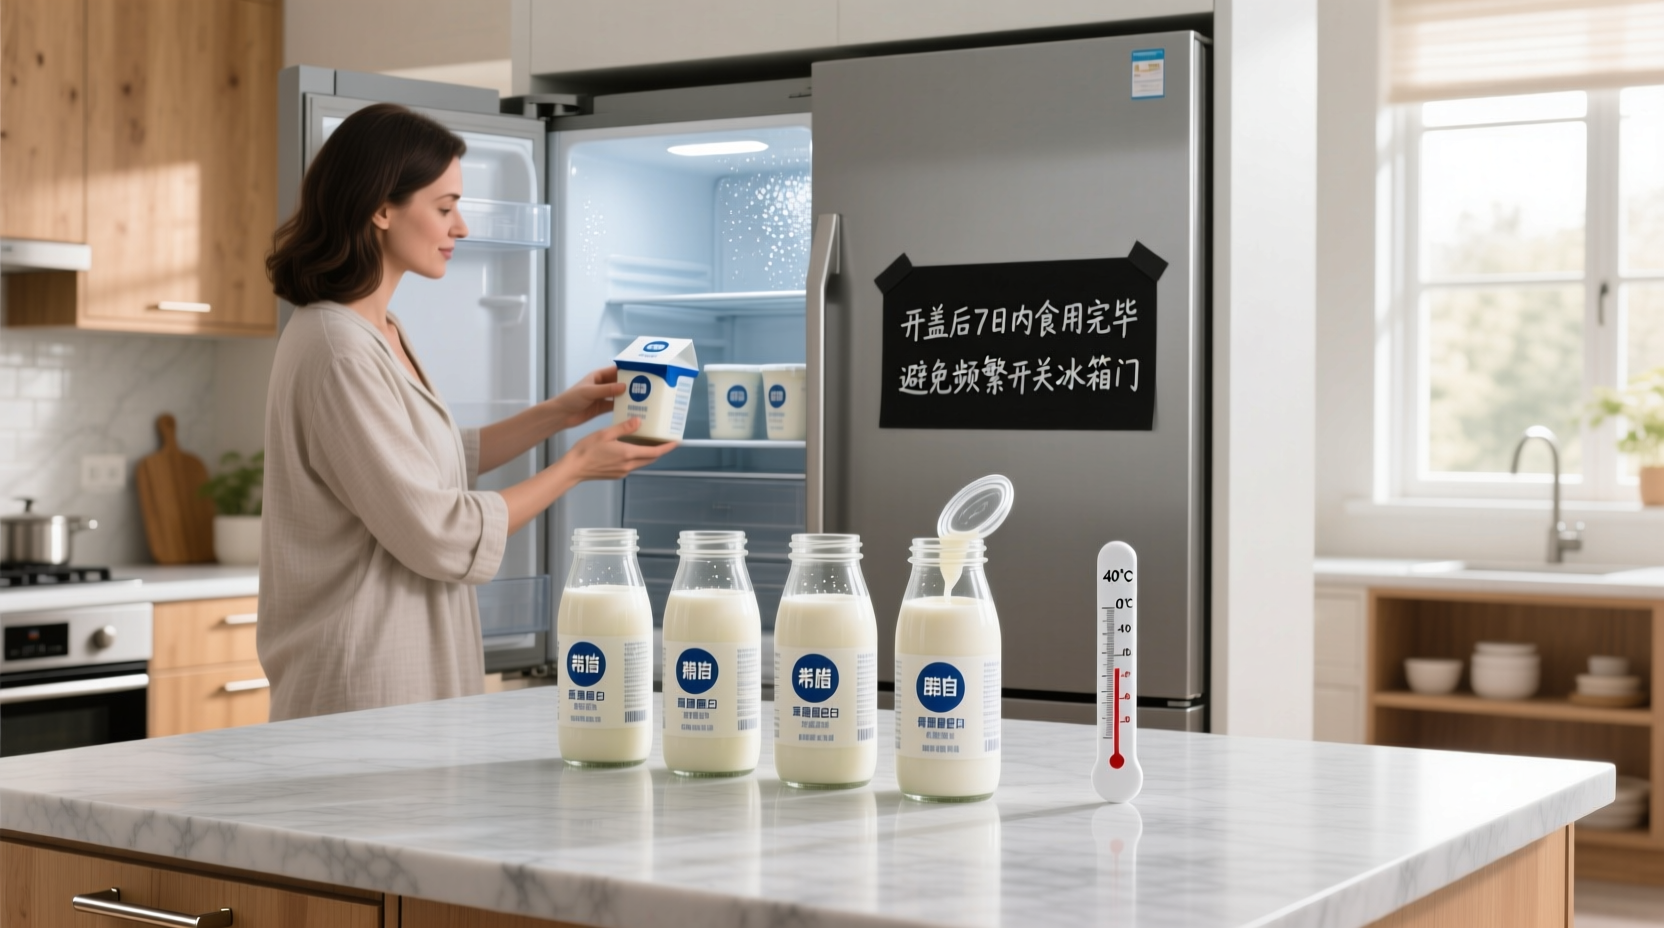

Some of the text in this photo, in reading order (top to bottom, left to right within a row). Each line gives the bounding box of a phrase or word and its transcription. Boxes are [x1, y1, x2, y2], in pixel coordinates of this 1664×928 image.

[900, 298, 1138, 342] 开盖后7日内食用完毕
[898, 354, 1140, 396] 避免频繁开关冰箱门
